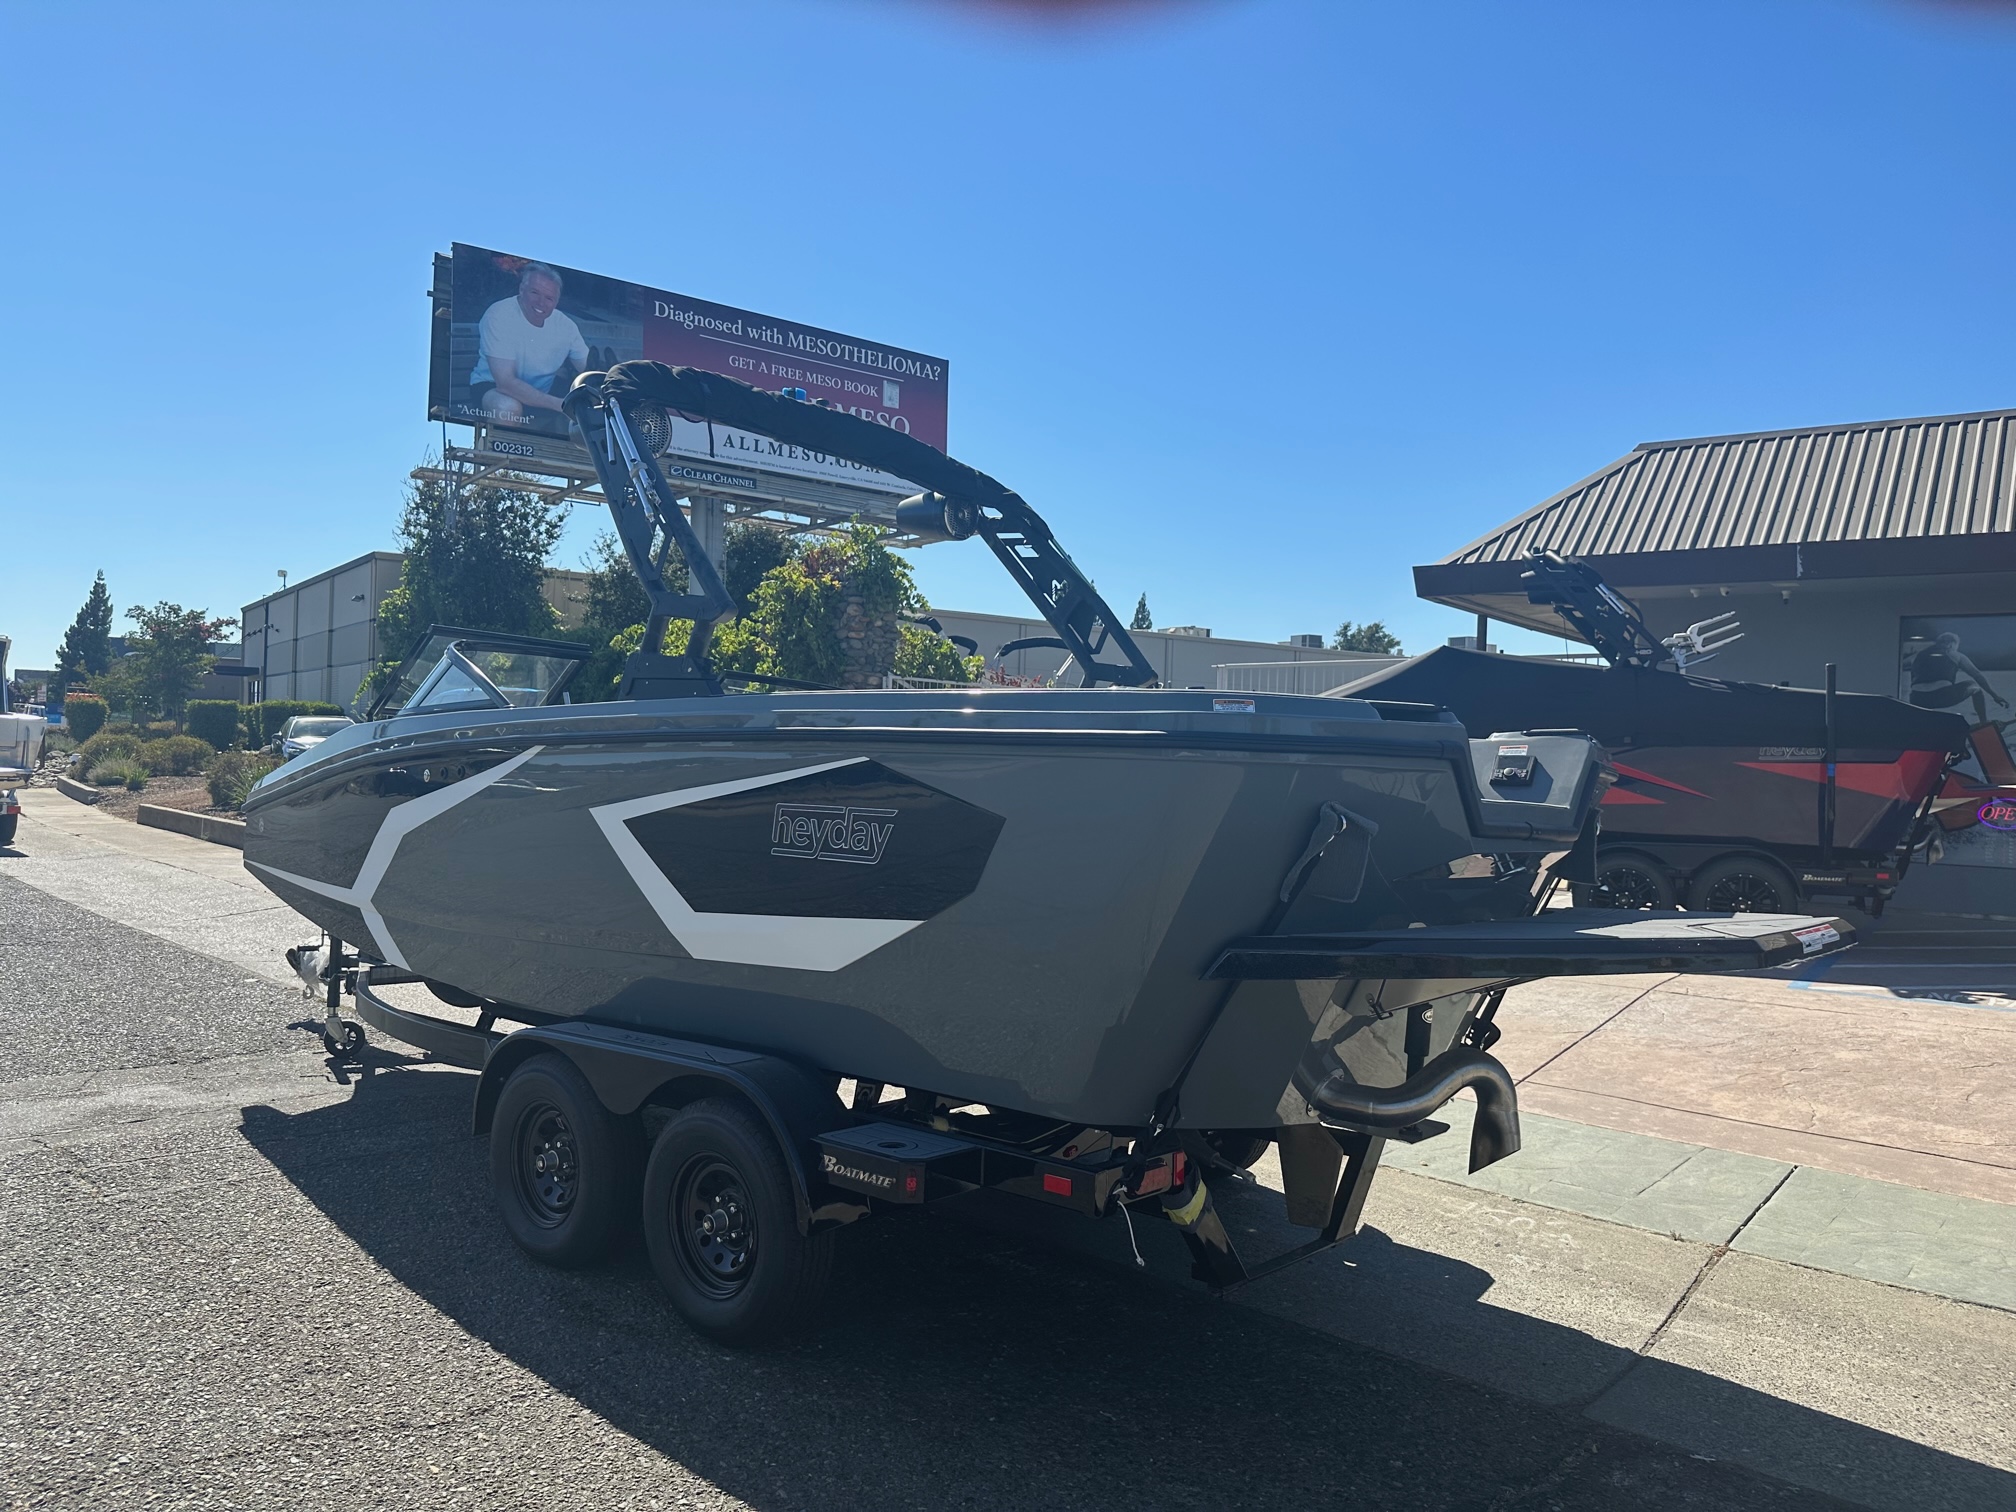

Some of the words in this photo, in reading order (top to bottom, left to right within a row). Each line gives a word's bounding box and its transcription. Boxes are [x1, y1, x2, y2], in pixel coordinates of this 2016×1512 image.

[654, 300, 743, 336] Diagnosed
[747, 326, 784, 346] with
[786, 331, 941, 381] MESOTHELIOMA?
[729, 355, 756, 370] GET
[758, 361, 768, 374] A
[771, 364, 803, 381] FREE
[805, 371, 841, 389] MESO
[844, 380, 879, 398] BOOK
[494, 441, 533, 456] 002312
[770, 802, 899, 865] heyday
